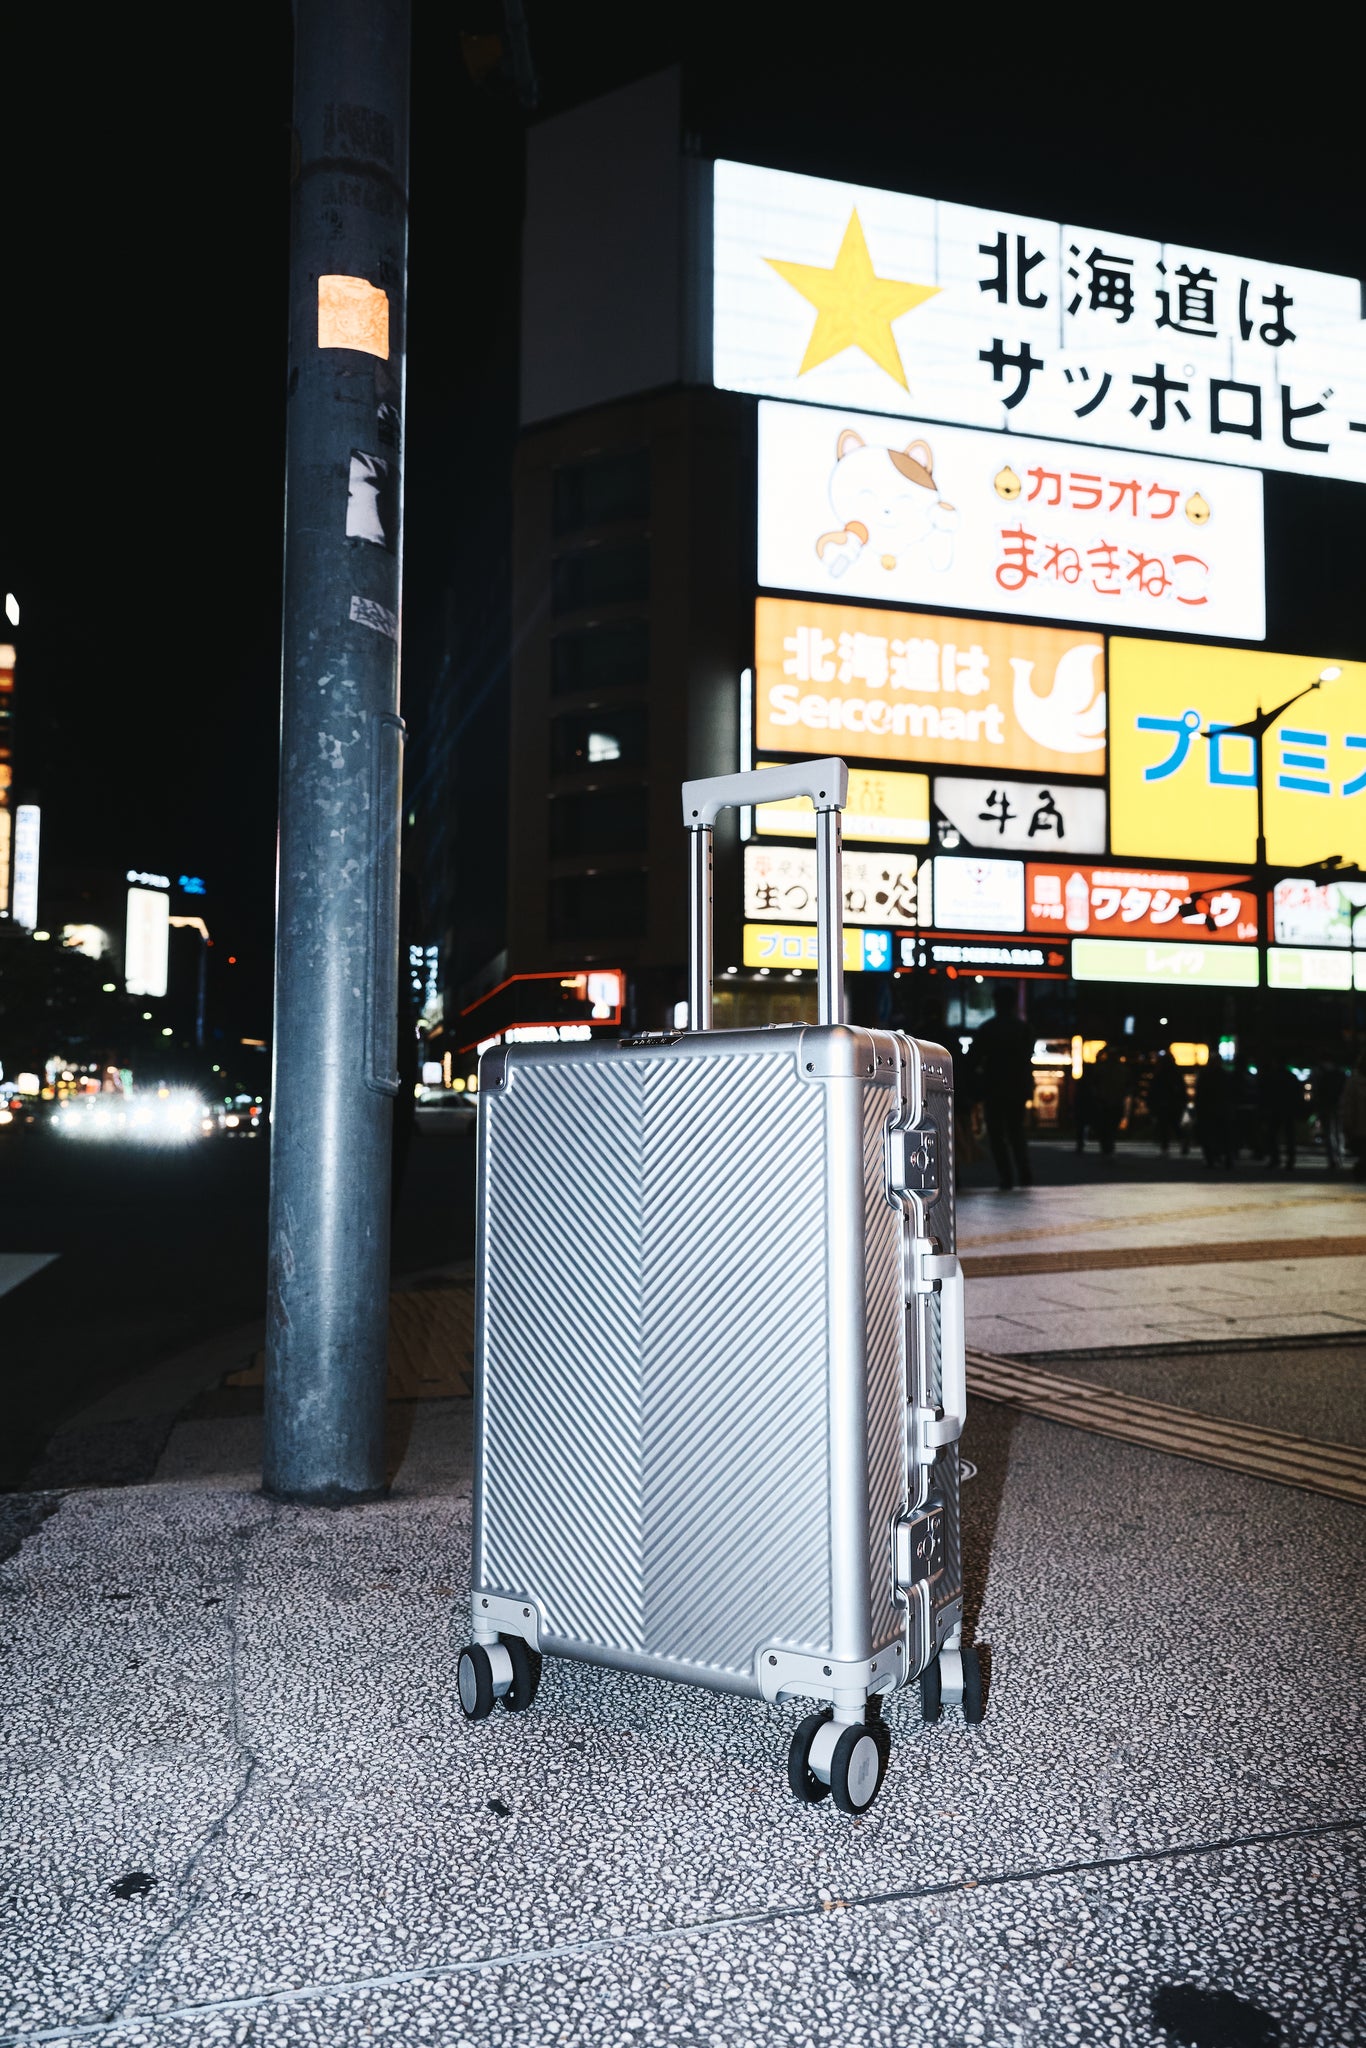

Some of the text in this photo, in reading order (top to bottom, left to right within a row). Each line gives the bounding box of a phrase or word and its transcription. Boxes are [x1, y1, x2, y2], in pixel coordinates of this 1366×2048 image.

[978, 231, 1297, 347] 北海道は
[1027, 466, 1181, 520] カラオケ
[995, 522, 1210, 606] まねきねこ
[783, 626, 991, 697] 北海道は
[768, 683, 1006, 745] Seicomart
[977, 789, 1066, 840] 牛角
